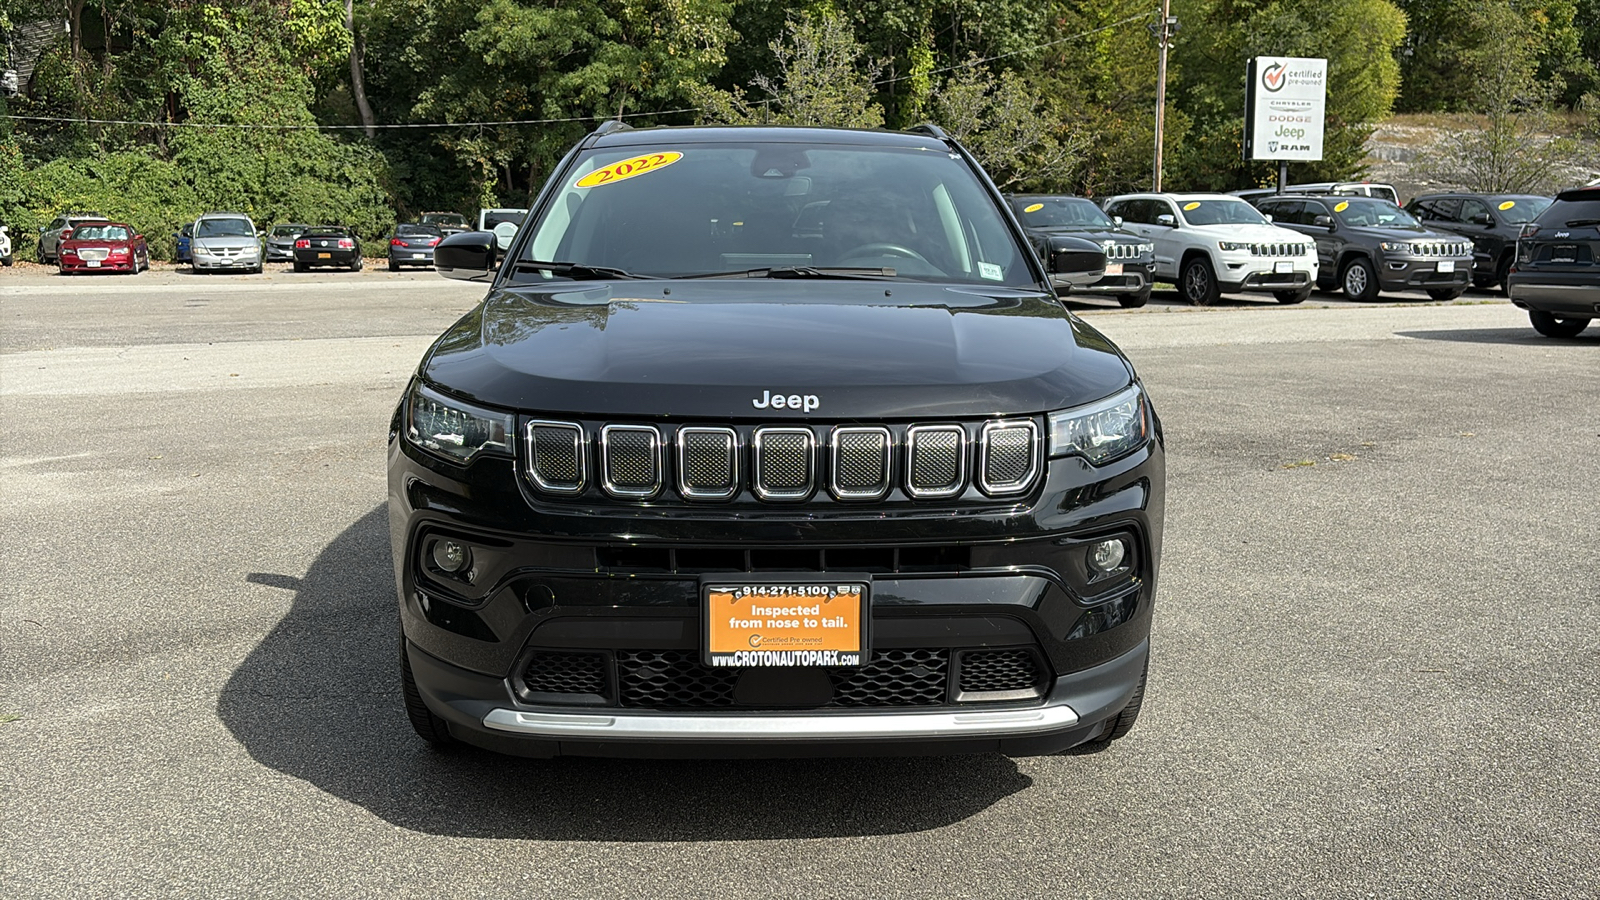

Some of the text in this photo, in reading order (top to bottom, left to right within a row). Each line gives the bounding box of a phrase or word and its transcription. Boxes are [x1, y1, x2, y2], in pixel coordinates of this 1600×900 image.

[1288, 70, 1322, 78] certified
[1269, 115, 1312, 123] DODGE
[1275, 124, 1305, 140] Jeep
[595, 154, 668, 184] 2022
[752, 389, 820, 413] Jeep
[742, 585, 830, 596] 914-271-5100
[751, 604, 820, 618] Inspected
[729, 616, 848, 629] from nose to tail.
